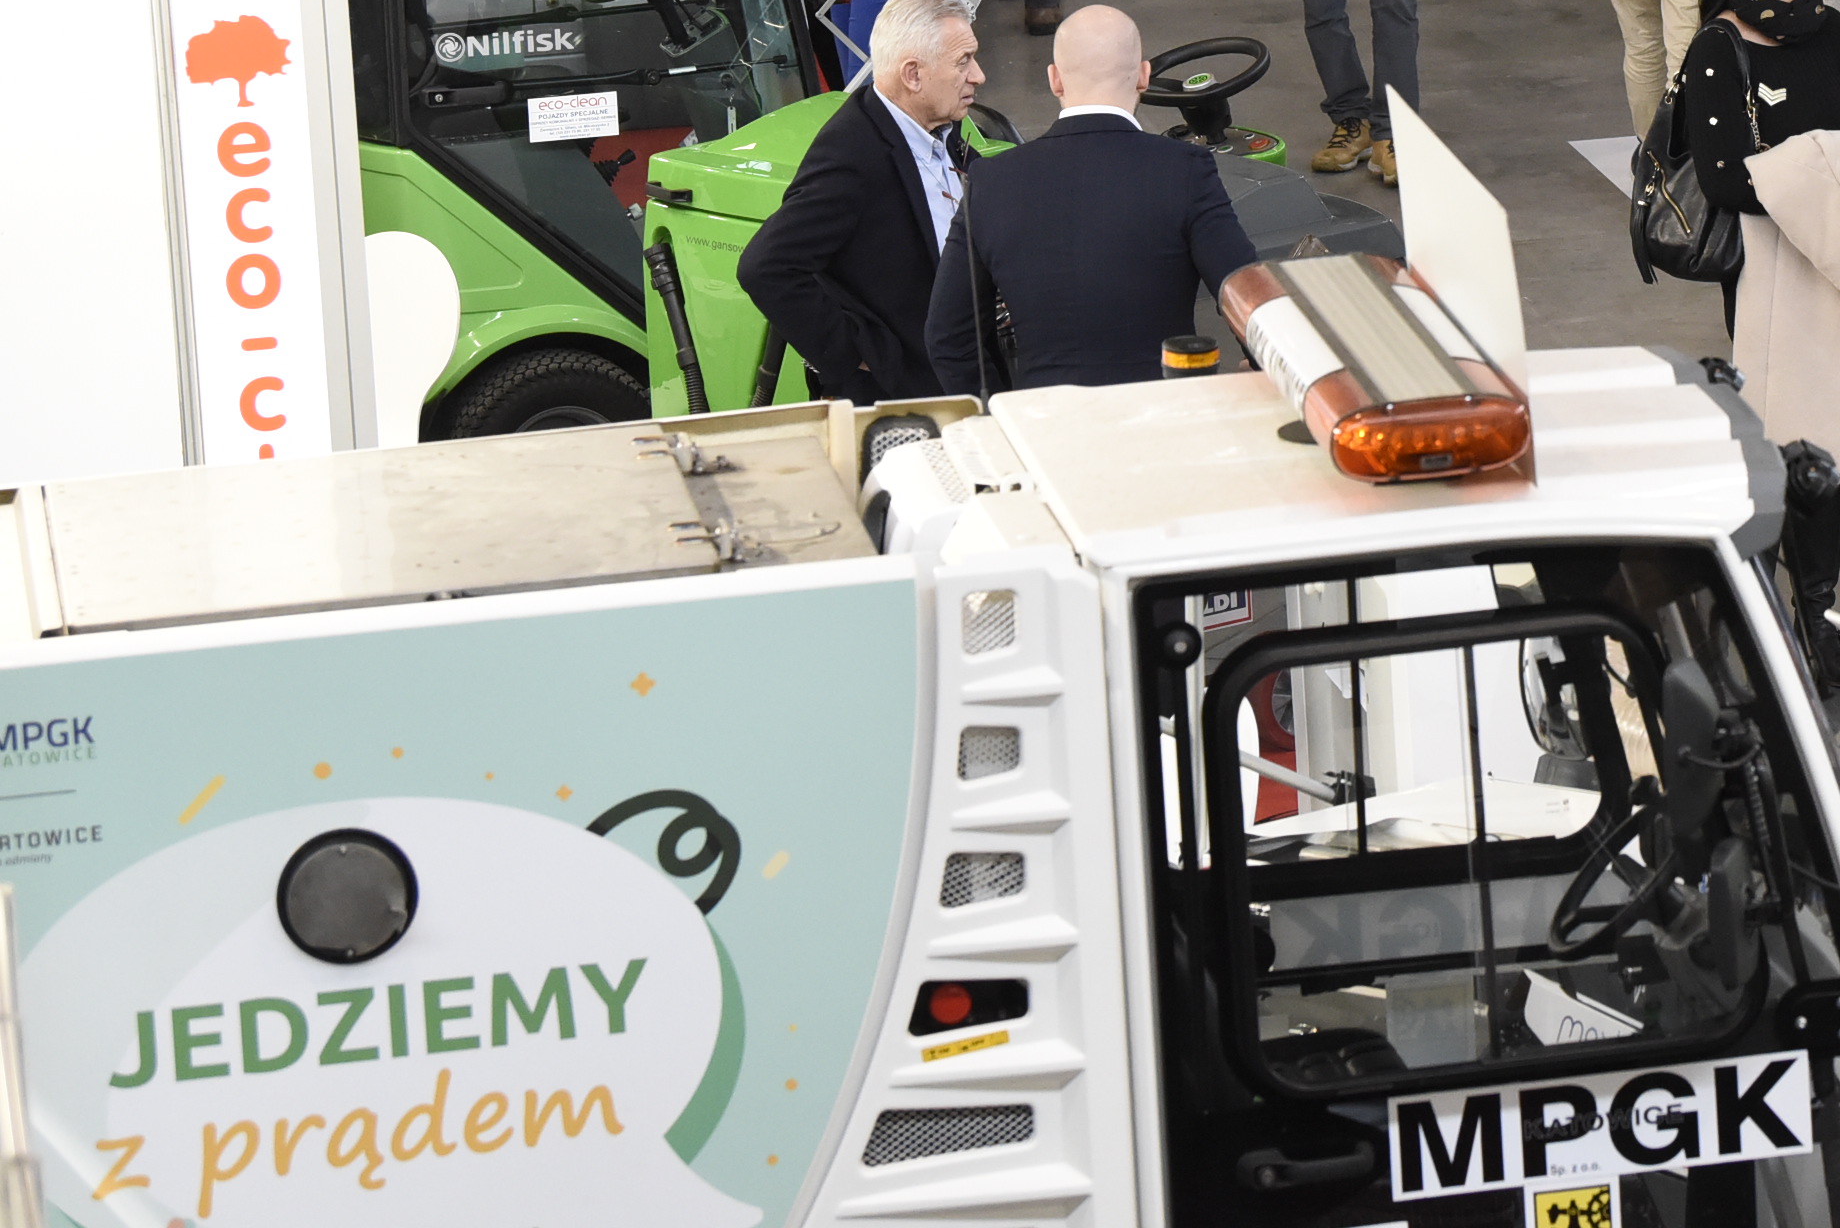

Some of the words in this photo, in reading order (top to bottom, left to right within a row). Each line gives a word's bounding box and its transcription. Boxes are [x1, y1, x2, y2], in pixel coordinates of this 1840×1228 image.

[466, 28, 575, 58] Nilfisk
[538, 95, 608, 111] eco-clean
[538, 112, 569, 120] POJAZDY
[570, 108, 609, 118] SPECJALNE
[108, 957, 648, 1089] JEDZIEMY
[91, 1134, 151, 1201] z
[197, 1067, 625, 1219] prądem
[1396, 1057, 1805, 1193] MPGK
